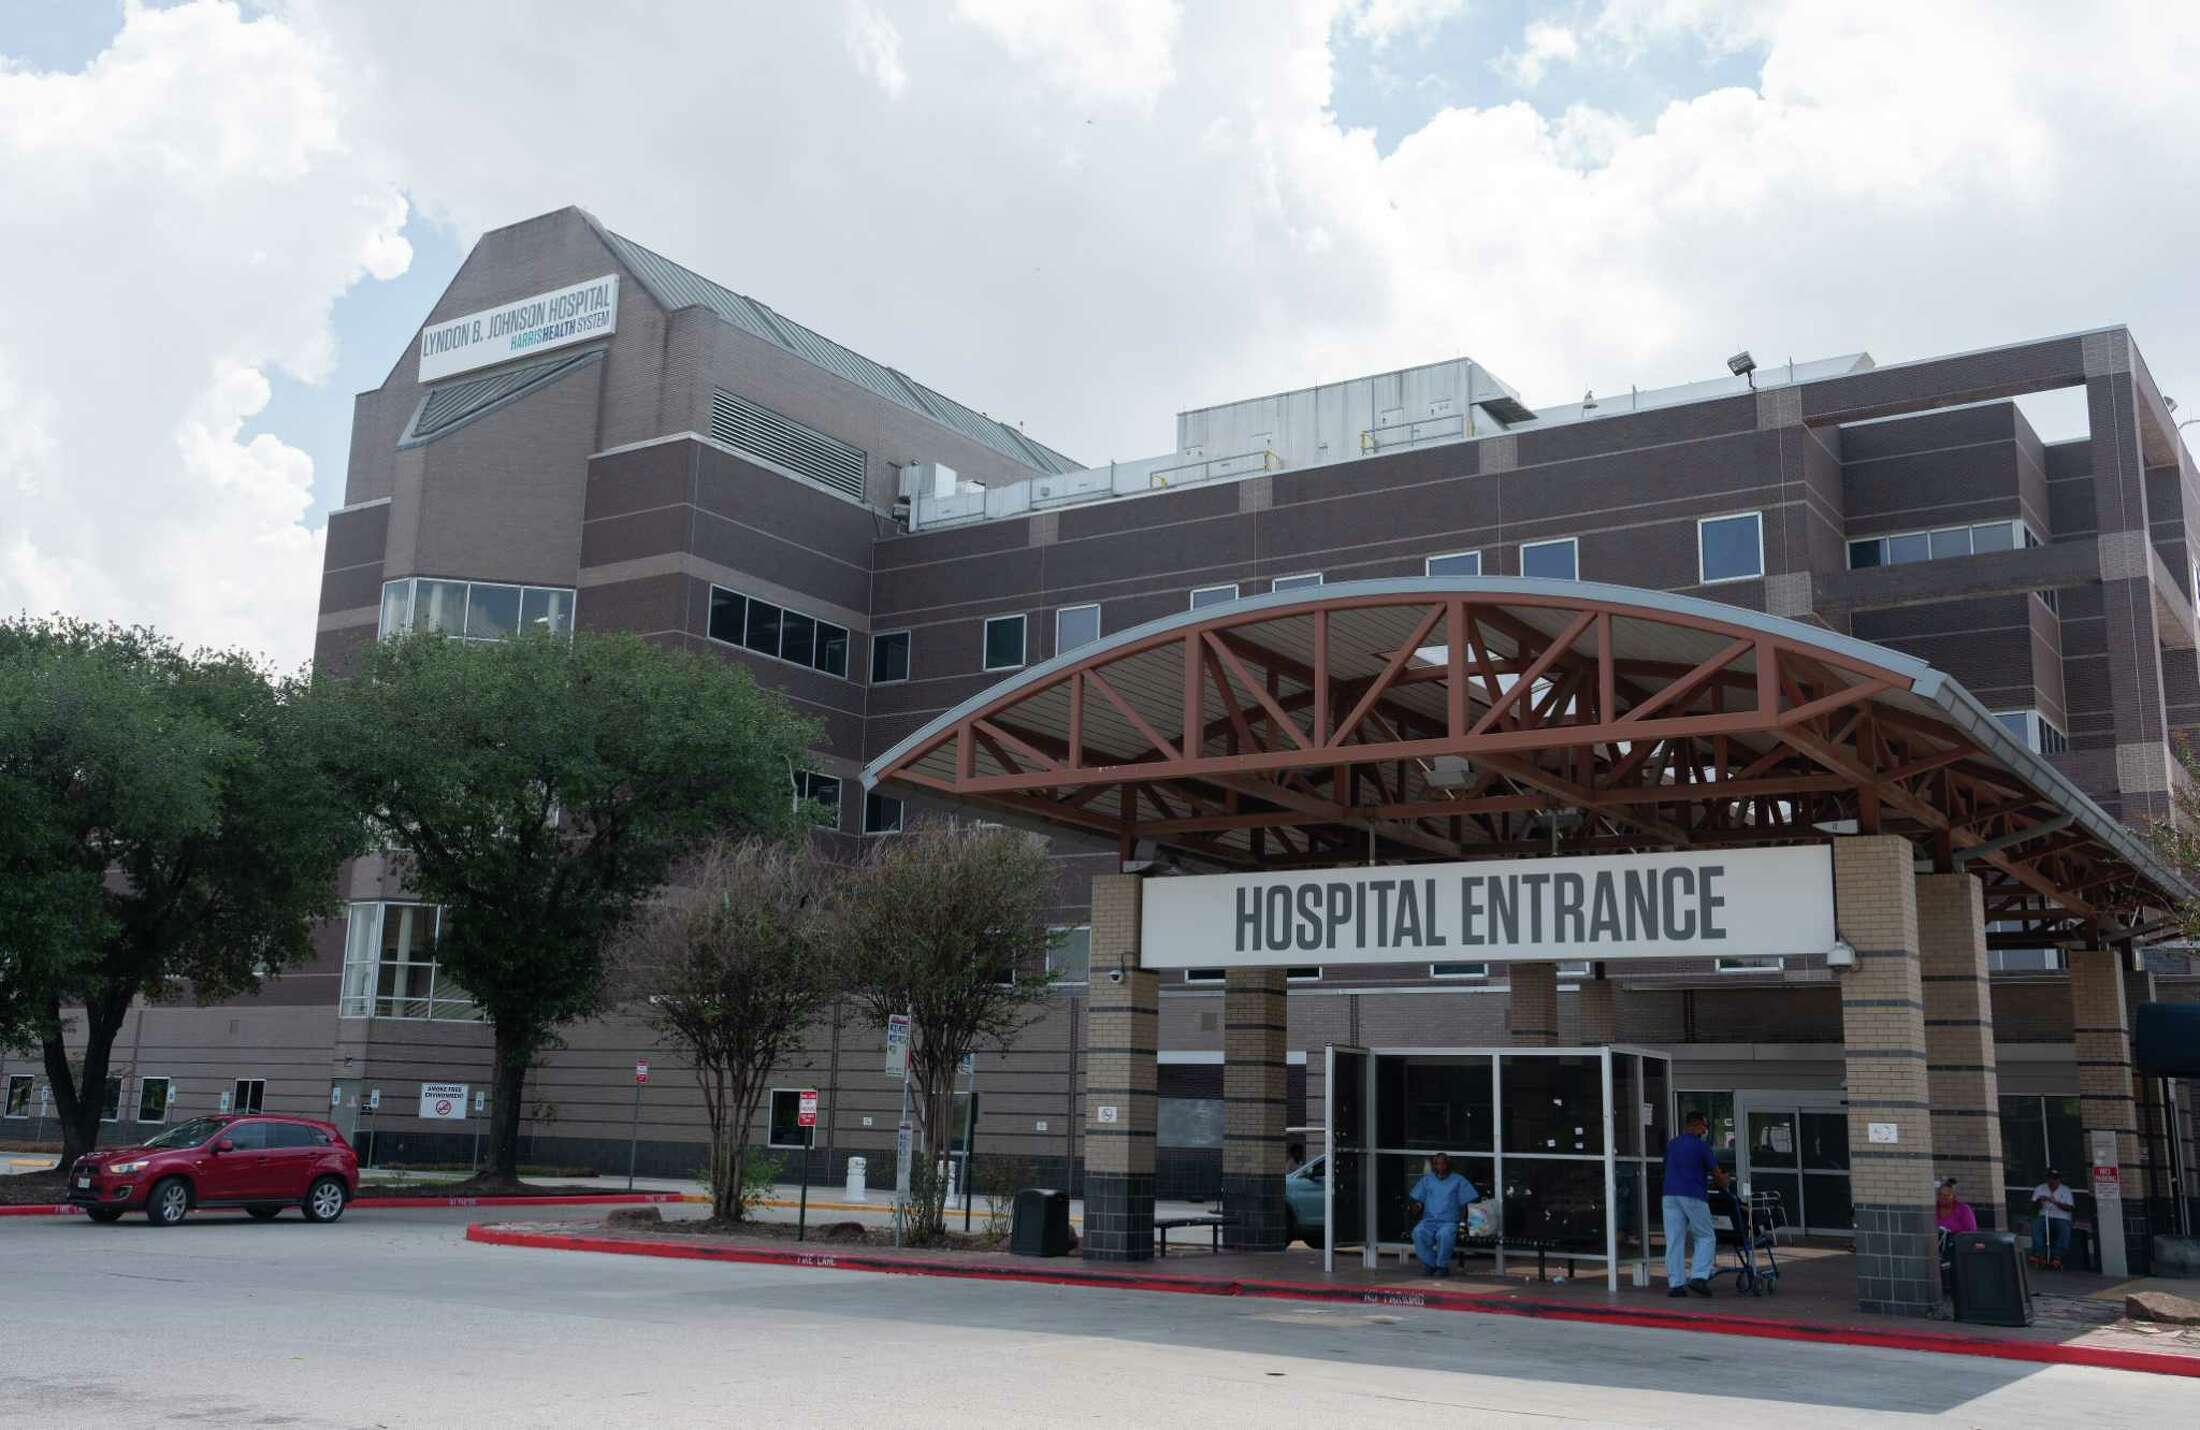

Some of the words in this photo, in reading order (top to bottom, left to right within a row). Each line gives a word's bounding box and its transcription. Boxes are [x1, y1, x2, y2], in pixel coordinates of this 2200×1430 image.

[422, 324, 469, 357] LYNDON
[472, 319, 483, 344] B.
[487, 302, 546, 340] JOHNSON
[550, 283, 610, 319] HOSPITAL
[577, 310, 610, 333] SYSTEM
[1236, 880, 1446, 951] HOSPITAL
[1462, 866, 1727, 945] ENTRANCE
